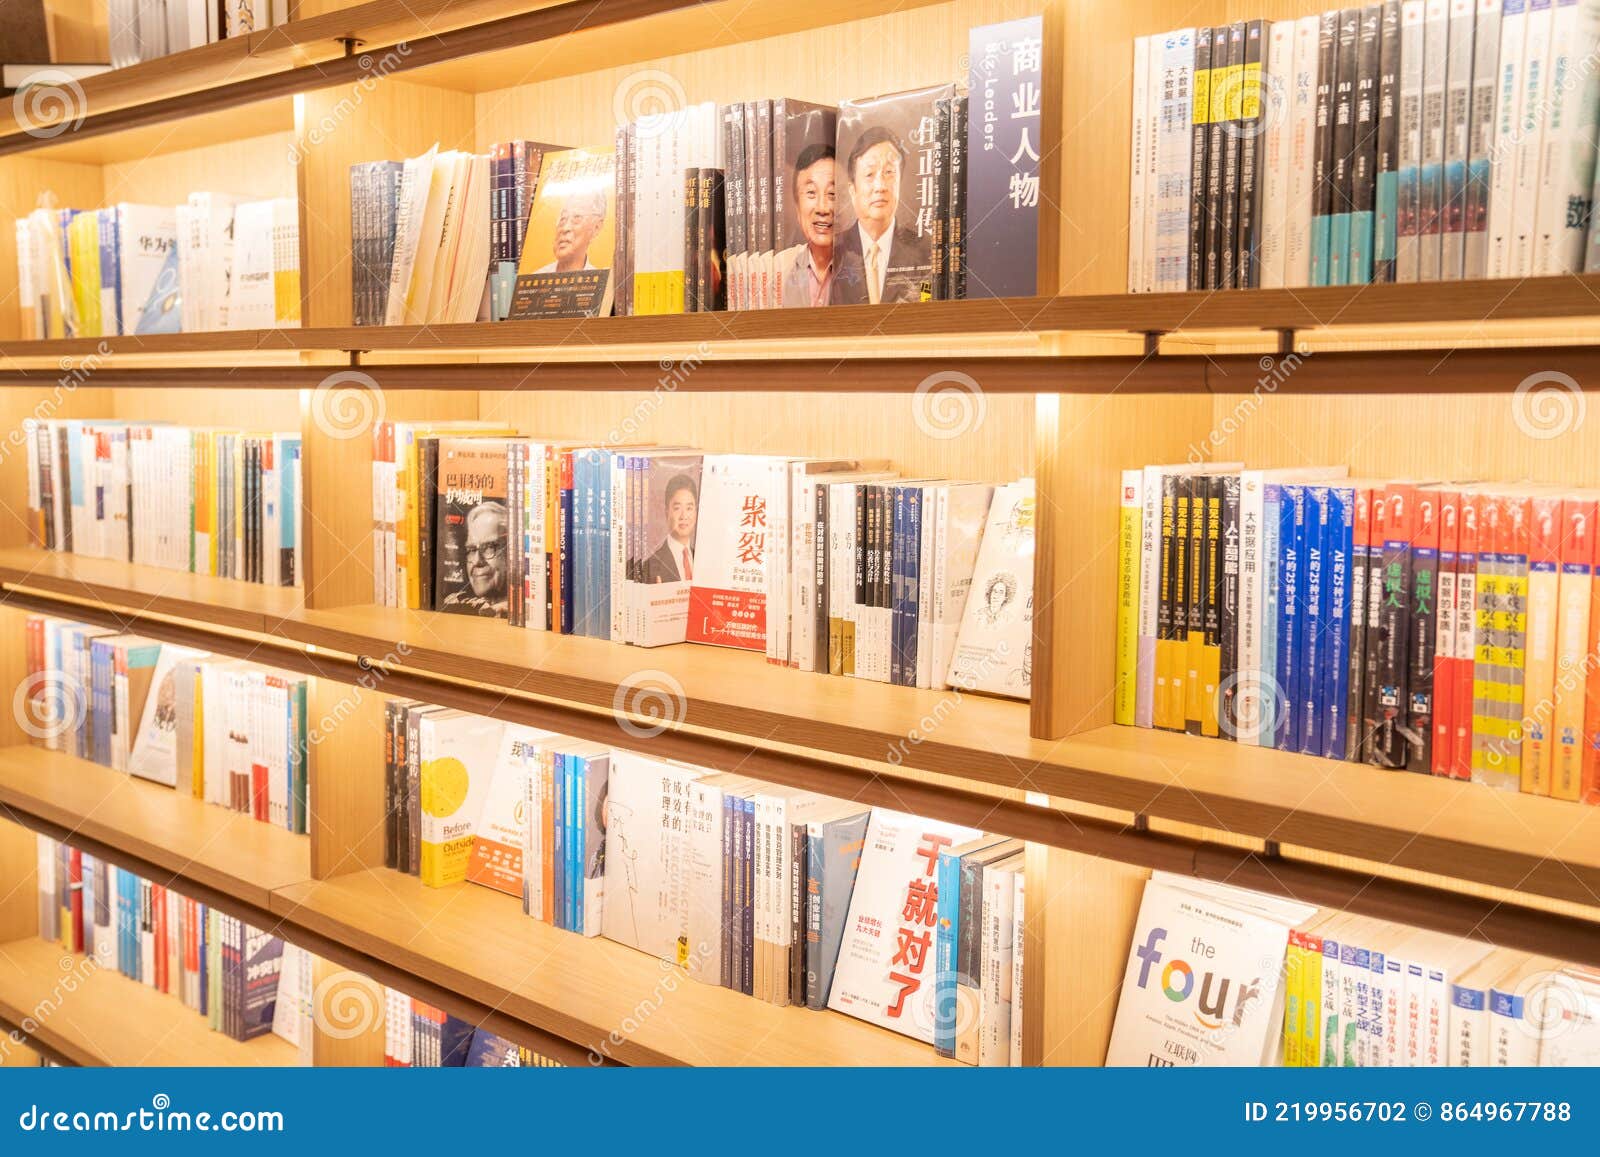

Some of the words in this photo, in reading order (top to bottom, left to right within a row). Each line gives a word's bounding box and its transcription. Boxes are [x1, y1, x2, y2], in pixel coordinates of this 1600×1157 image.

[1009, 38, 1042, 209] 商业人物
[775, 176, 783, 213] 任正非传
[915, 116, 933, 238] 任正非传
[446, 473, 495, 490] 巴菲特的
[736, 495, 767, 565] 聚裂
[1225, 521, 1238, 574] 人工智能
[1245, 512, 1256, 573] 大数据应用
[1385, 562, 1402, 608] 虚拟人
[1416, 569, 1431, 614] 虚拟人
[1440, 577, 1452, 632] 数据的本质
[1460, 578, 1471, 633] 数据的本质
[443, 821, 472, 836] Before
[661, 777, 671, 828] 管理者
[887, 833, 953, 1018] 干就对了
[1191, 936, 1216, 959] the
[1136, 927, 1260, 1028] four
[1356, 982, 1369, 1032] 转型之战
[1371, 986, 1383, 1038] 转型之战
[1164, 1039, 1198, 1064] 互联网
